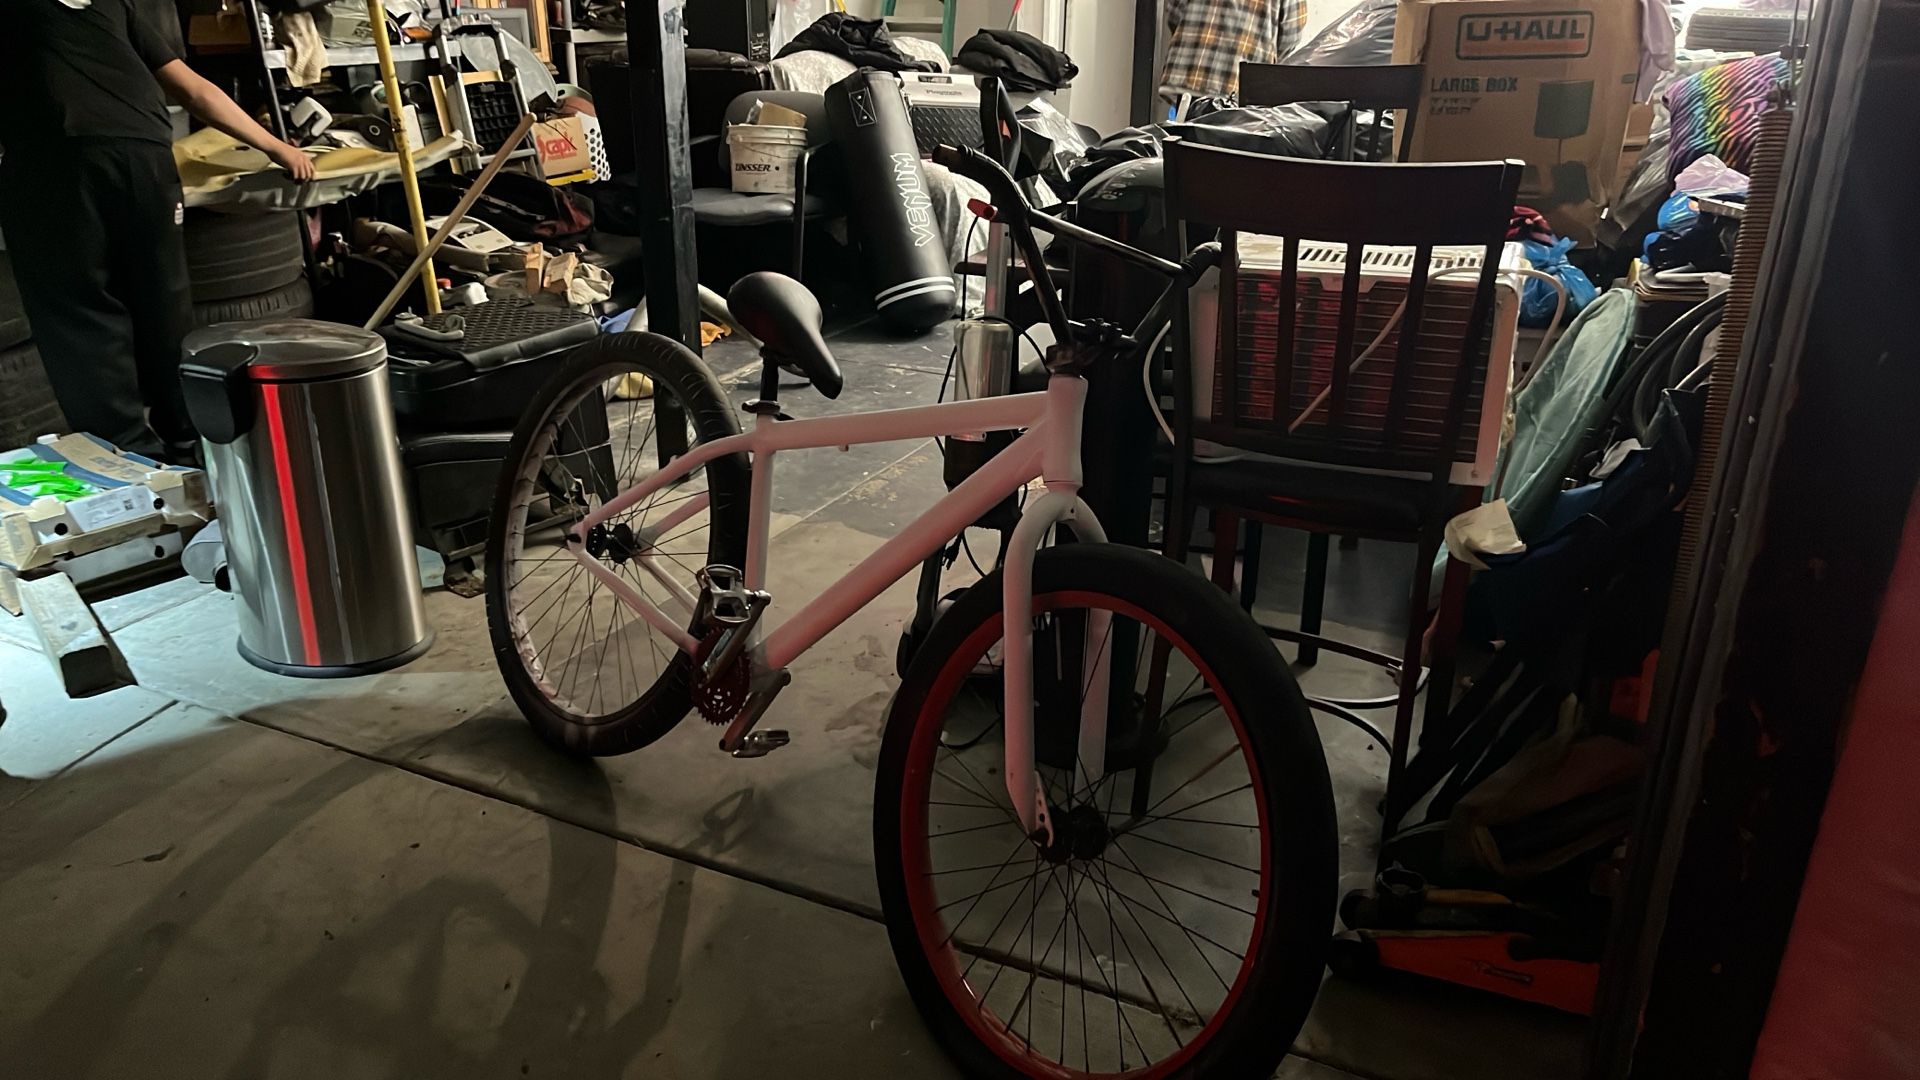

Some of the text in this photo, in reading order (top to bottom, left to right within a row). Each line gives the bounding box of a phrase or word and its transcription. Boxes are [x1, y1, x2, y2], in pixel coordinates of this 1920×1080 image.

[1466, 19, 1585, 41] U-HAUL
[1431, 77, 1519, 93] LARGE BOX
[891, 152, 936, 247] VENUM
